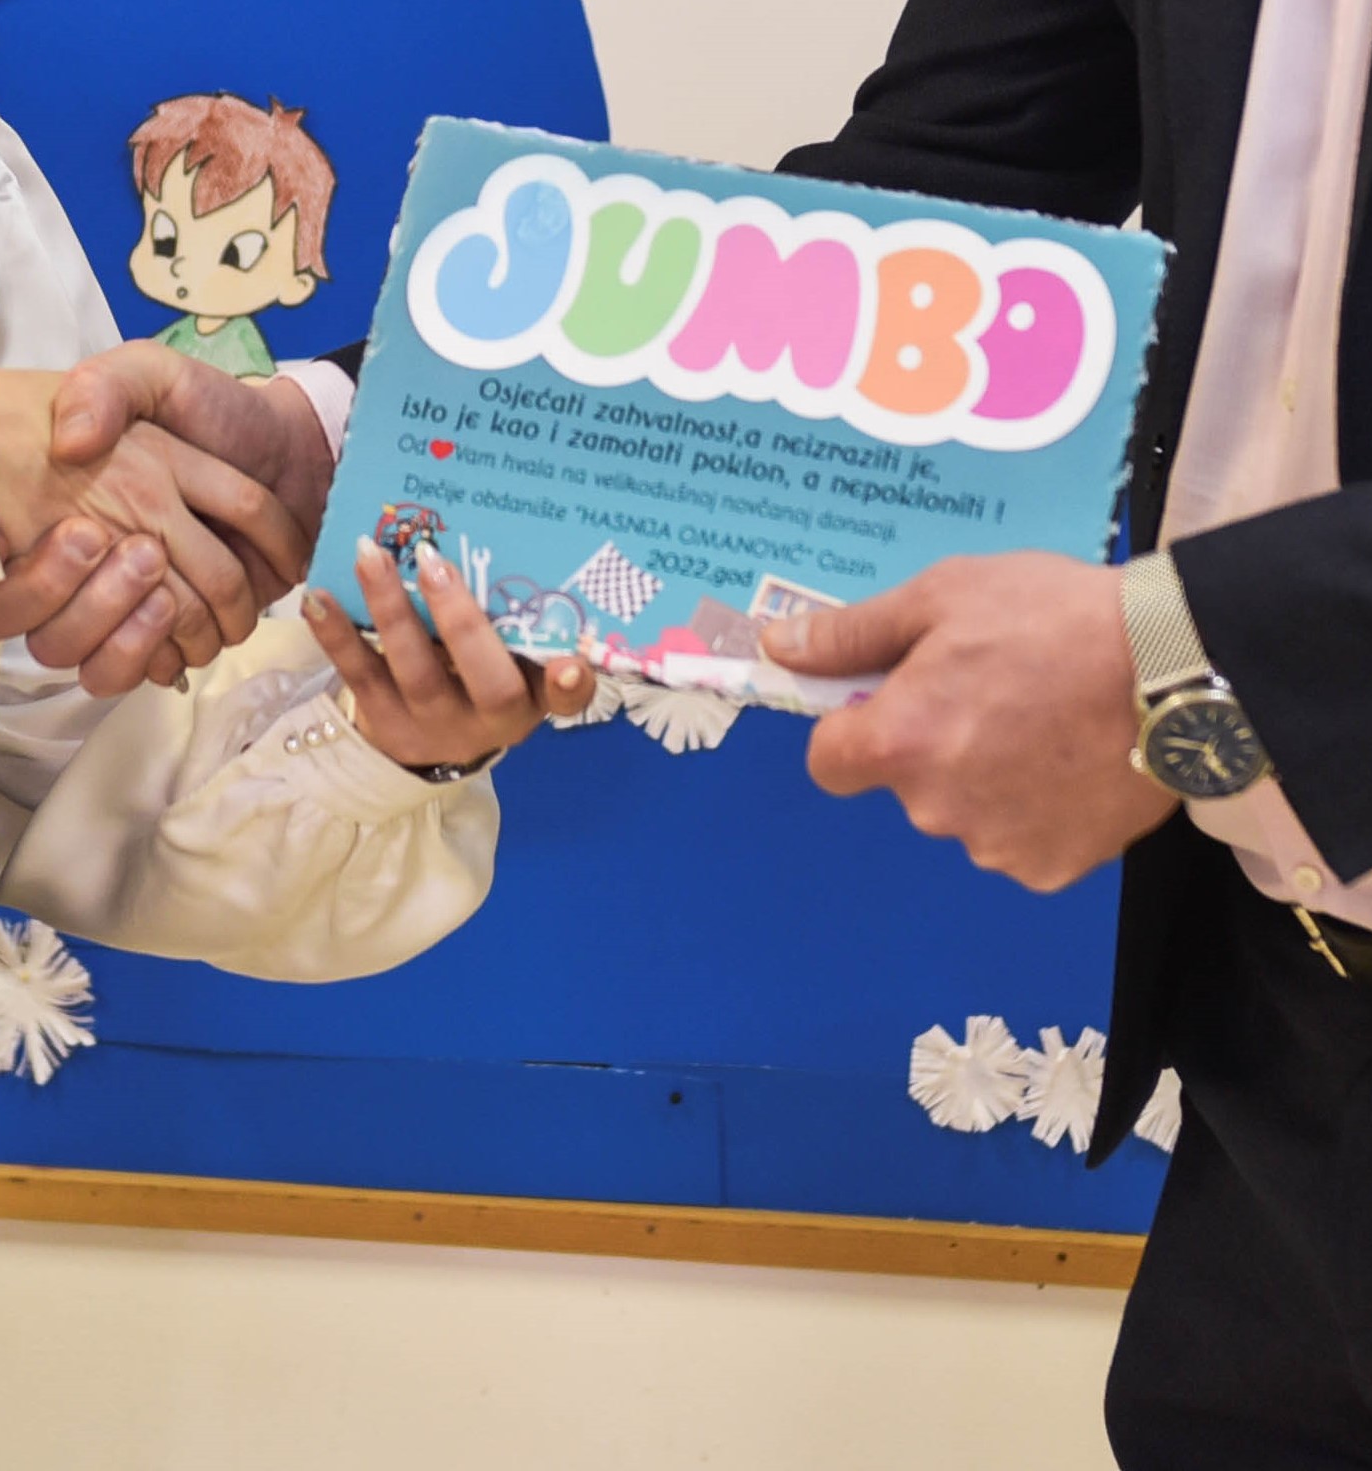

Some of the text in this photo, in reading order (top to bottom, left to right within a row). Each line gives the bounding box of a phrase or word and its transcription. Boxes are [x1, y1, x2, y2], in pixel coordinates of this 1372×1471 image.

[435, 180, 1086, 421] JUMBO
[397, 433, 429, 457] Od
[453, 442, 497, 469] Vam
[501, 450, 556, 479] hvala
[561, 463, 587, 487] na
[401, 393, 448, 424] isto
[454, 403, 481, 432] je
[490, 409, 541, 441] kao
[550, 420, 560, 444] i
[566, 427, 683, 467] zamotati
[690, 450, 790, 490] poklon,
[802, 470, 821, 491] a
[830, 474, 986, 522] nepokloniti
[478, 377, 587, 417] Osjećati
[771, 432, 902, 474] neizraziti
[906, 450, 941, 484] je,
[470, 488, 568, 522] obdanište
